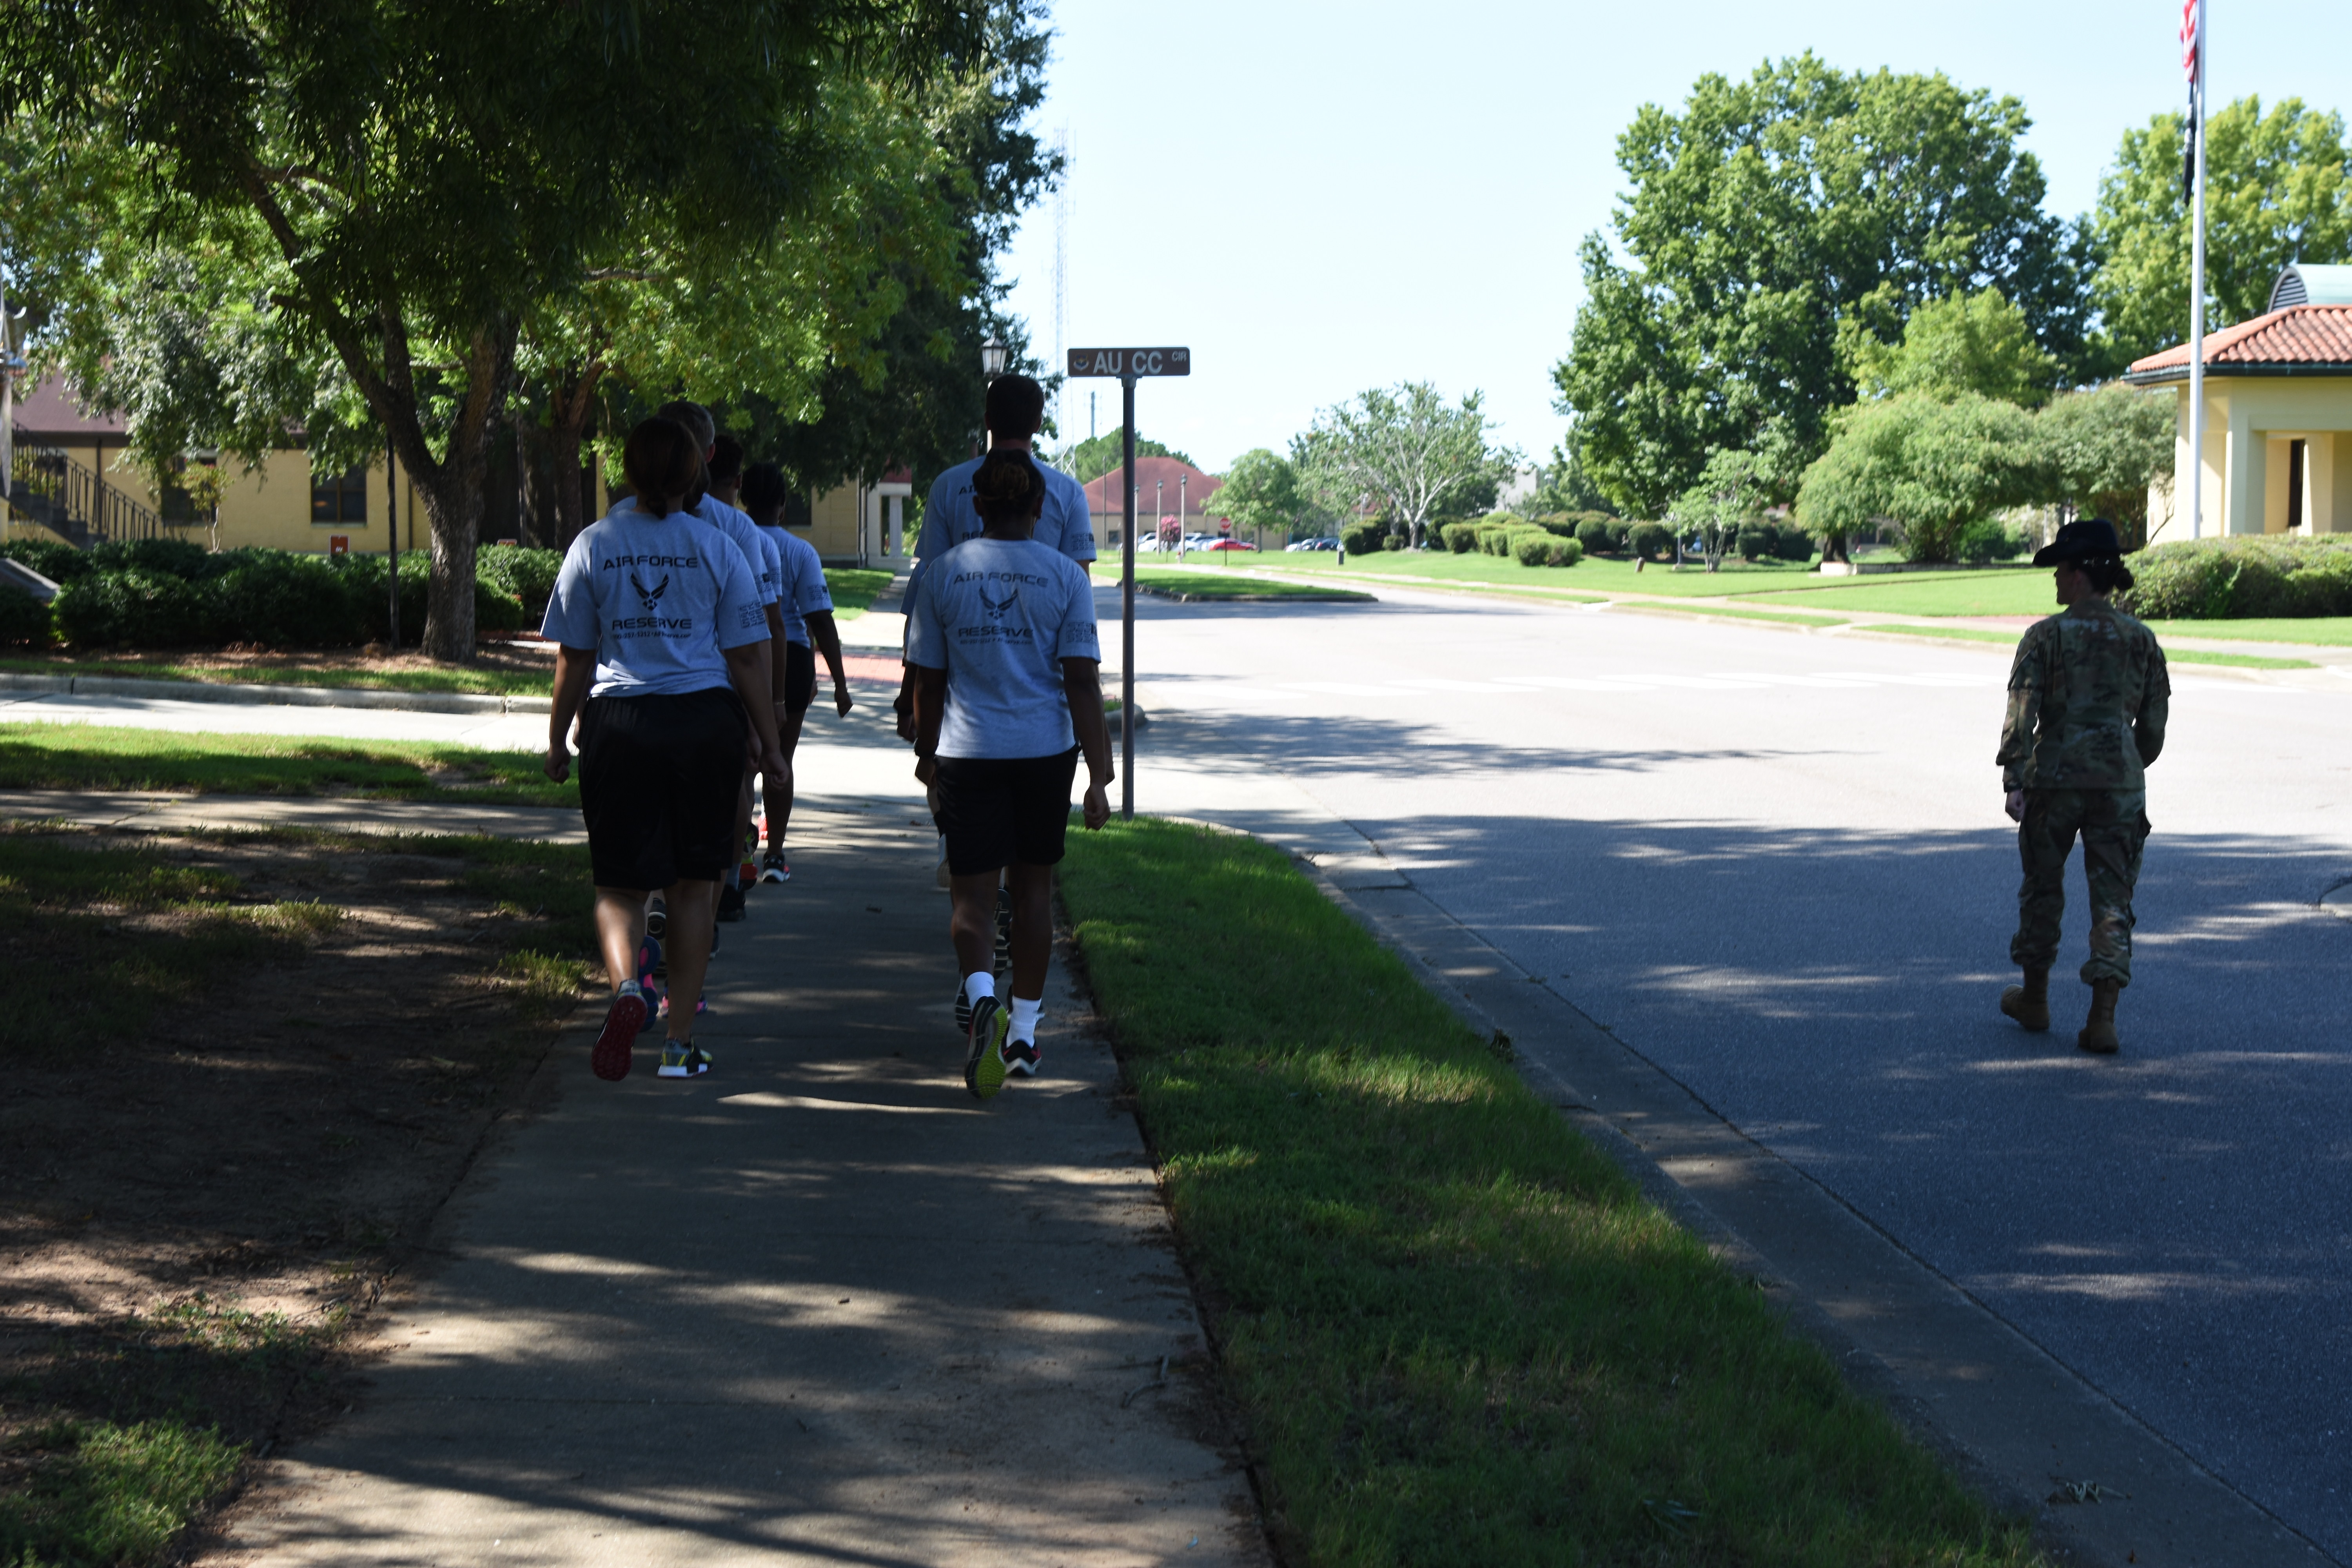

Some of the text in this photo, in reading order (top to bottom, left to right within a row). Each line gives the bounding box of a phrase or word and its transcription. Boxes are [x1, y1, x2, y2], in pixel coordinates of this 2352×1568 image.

[1093, 350, 1187, 374] AU CC CIR
[603, 555, 698, 571] AIR FORCE
[954, 571, 1049, 588] AIR FORCE
[612, 617, 692, 630] RESERVE
[958, 625, 1033, 639] RESERVE
